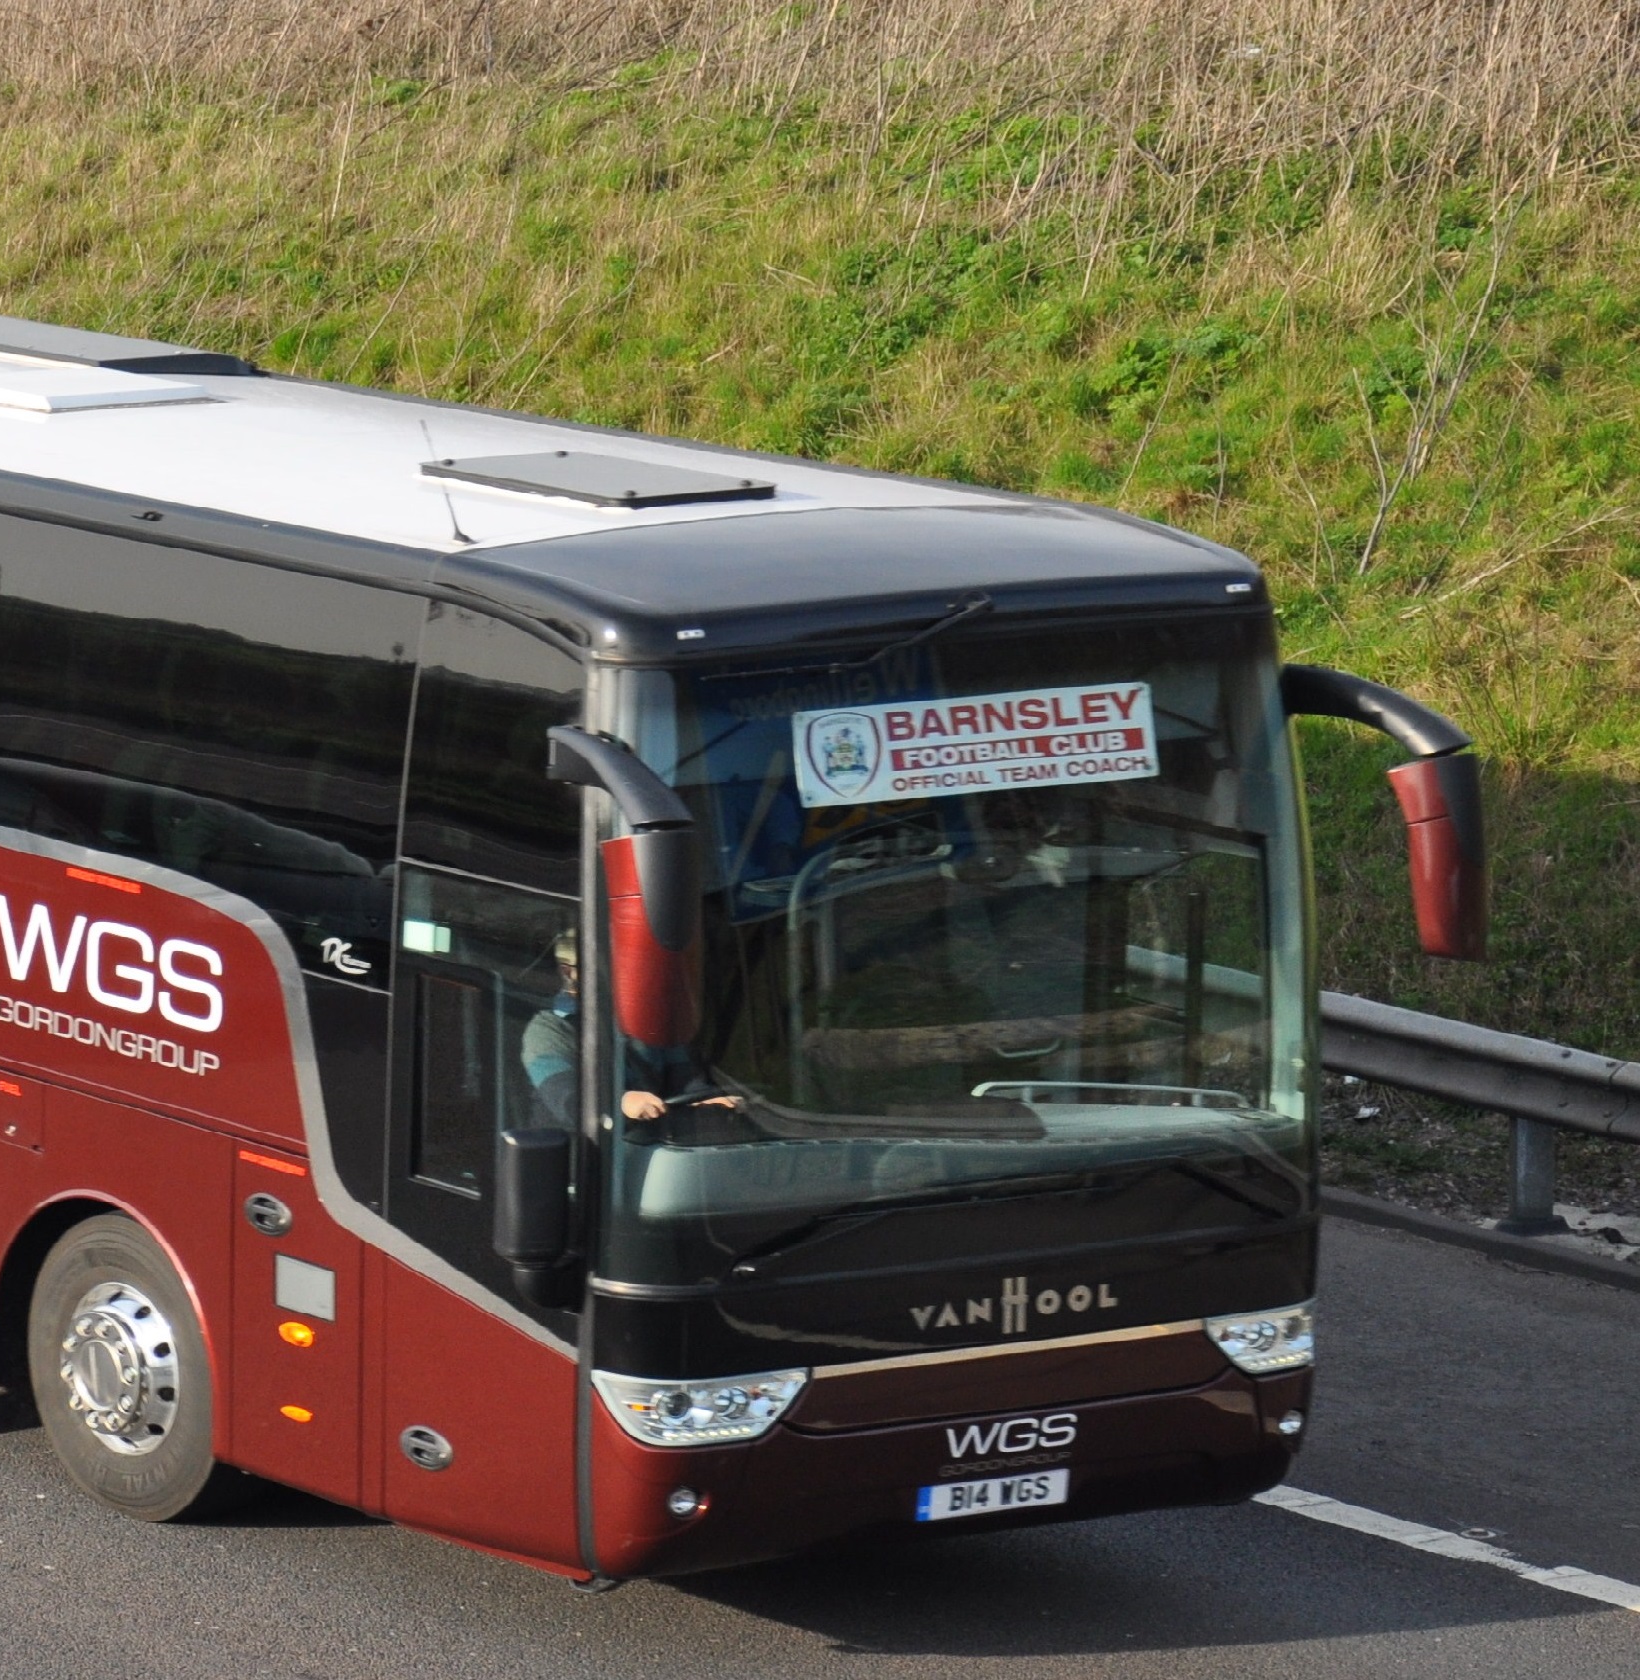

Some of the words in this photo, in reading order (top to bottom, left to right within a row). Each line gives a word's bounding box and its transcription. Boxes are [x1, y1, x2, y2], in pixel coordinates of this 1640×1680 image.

[885, 689, 1139, 741] BARNSLEY
[902, 739, 1045, 769] FOOTBALL
[1048, 731, 1127, 755] CLUB
[892, 770, 991, 791] OFFICIAL
[996, 762, 1059, 782] TEAM
[1065, 755, 1150, 777] COACH
[946, 1413, 1078, 1458] WGS
[939, 1451, 1071, 1478] GORDONGROUP
[949, 1482, 989, 1511] B14
[1000, 1475, 1050, 1506] WGS
